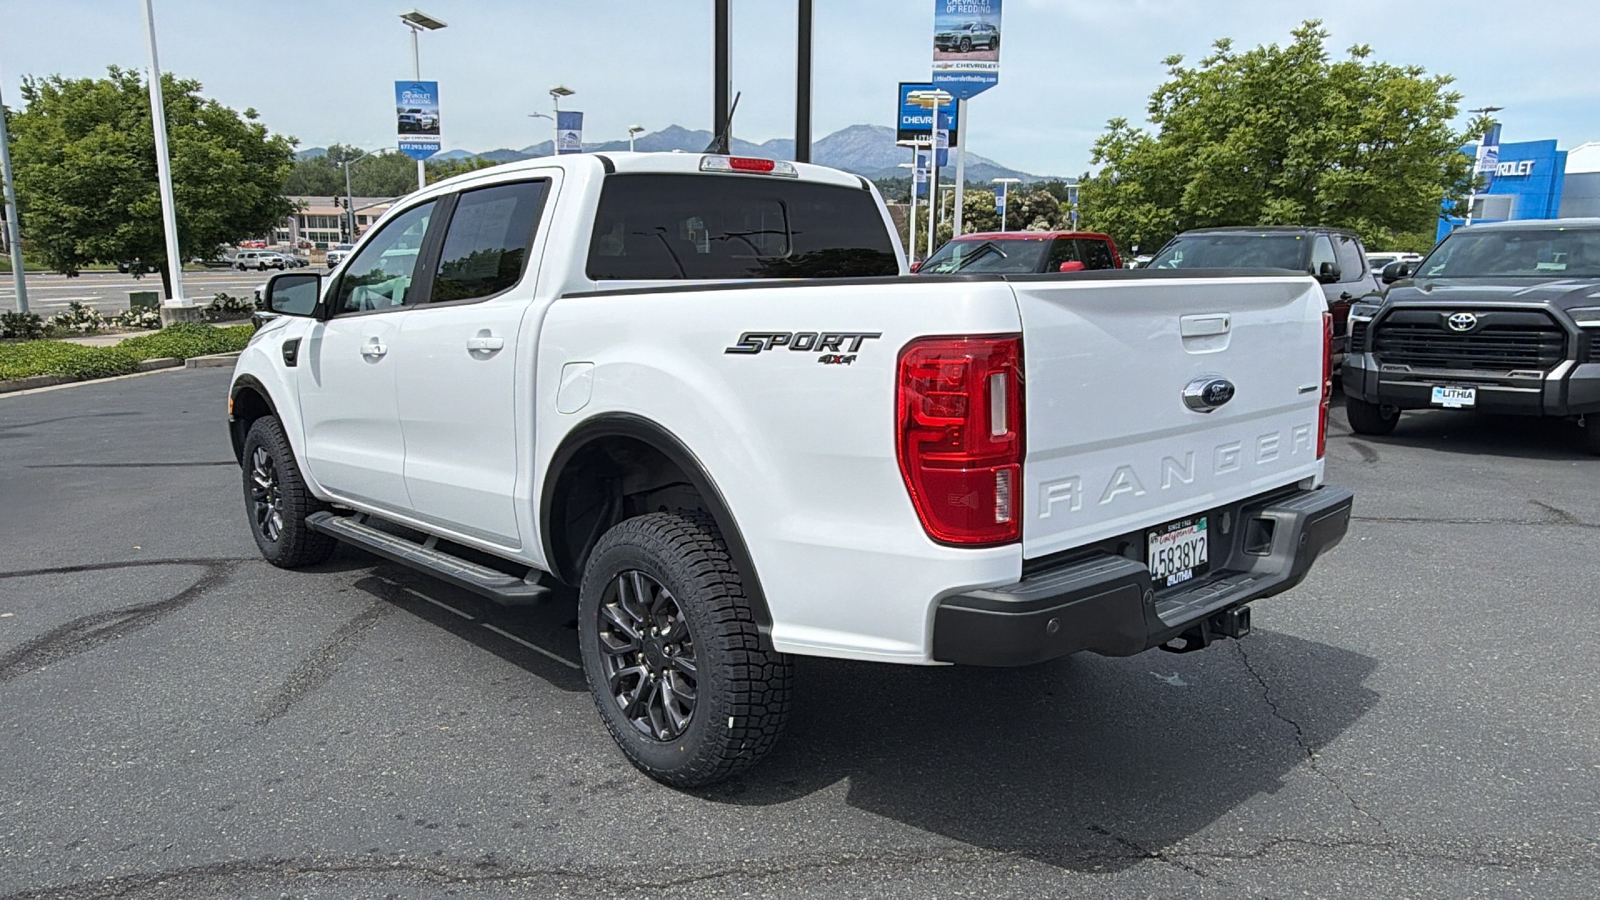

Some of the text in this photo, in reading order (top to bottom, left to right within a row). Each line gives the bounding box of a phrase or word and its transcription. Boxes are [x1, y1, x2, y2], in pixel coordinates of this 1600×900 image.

[946, 5, 991, 13] OF REDDING
[903, 116, 953, 124] CHEVRT
[724, 331, 883, 355] SPORT
[1442, 389, 1473, 399] LITHIA
[1038, 422, 1313, 520] RANGER
[1151, 536, 1206, 578] 45838Y2
